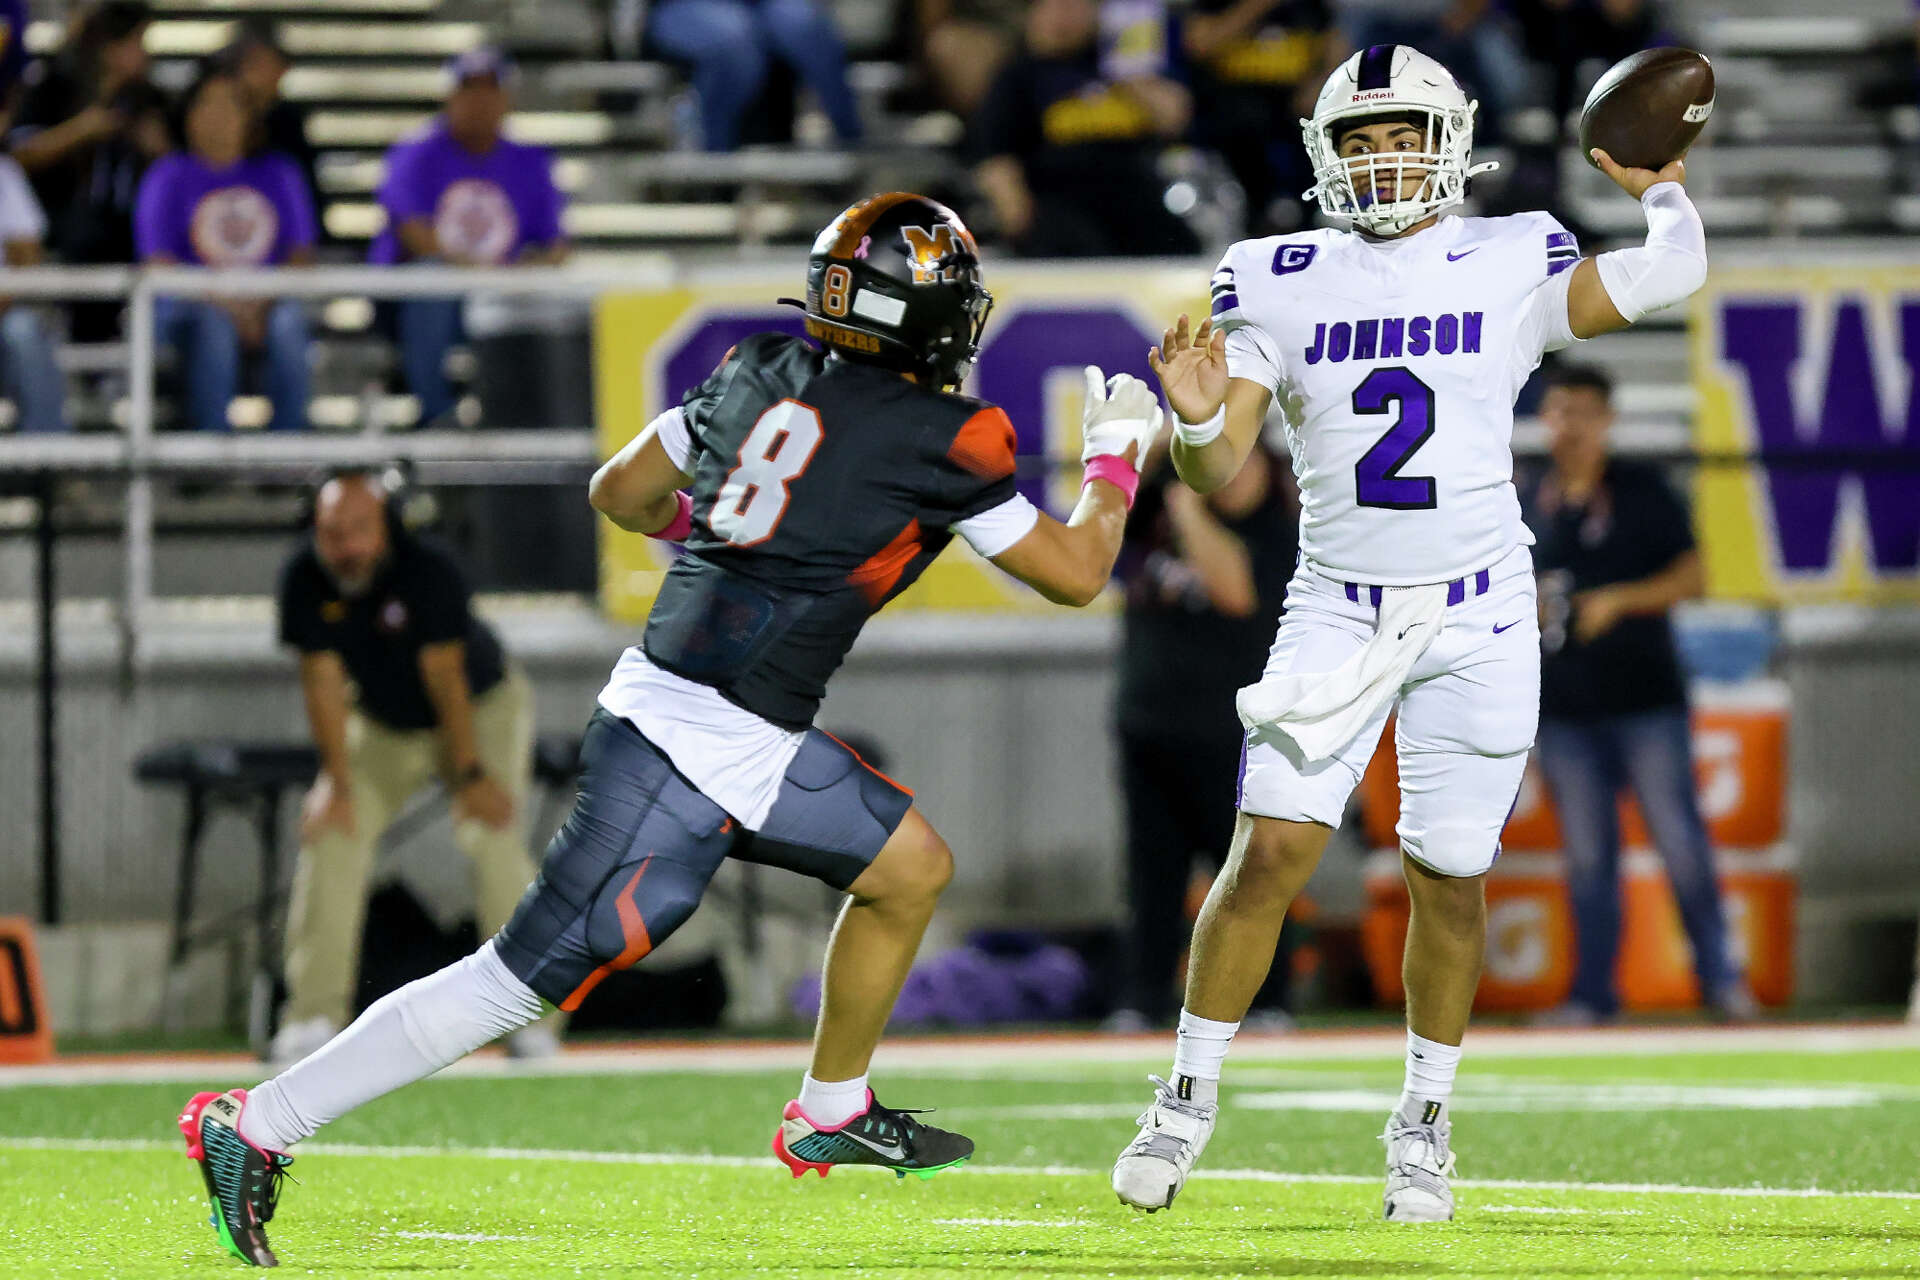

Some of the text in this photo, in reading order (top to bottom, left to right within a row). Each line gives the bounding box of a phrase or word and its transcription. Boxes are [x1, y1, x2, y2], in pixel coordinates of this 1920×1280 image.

[1352, 92, 1394, 102] Riddell
[823, 264, 852, 317] 8
[1304, 311, 1484, 366] JOHNSON
[1351, 366, 1436, 509] 2
[707, 397, 825, 549] 8
